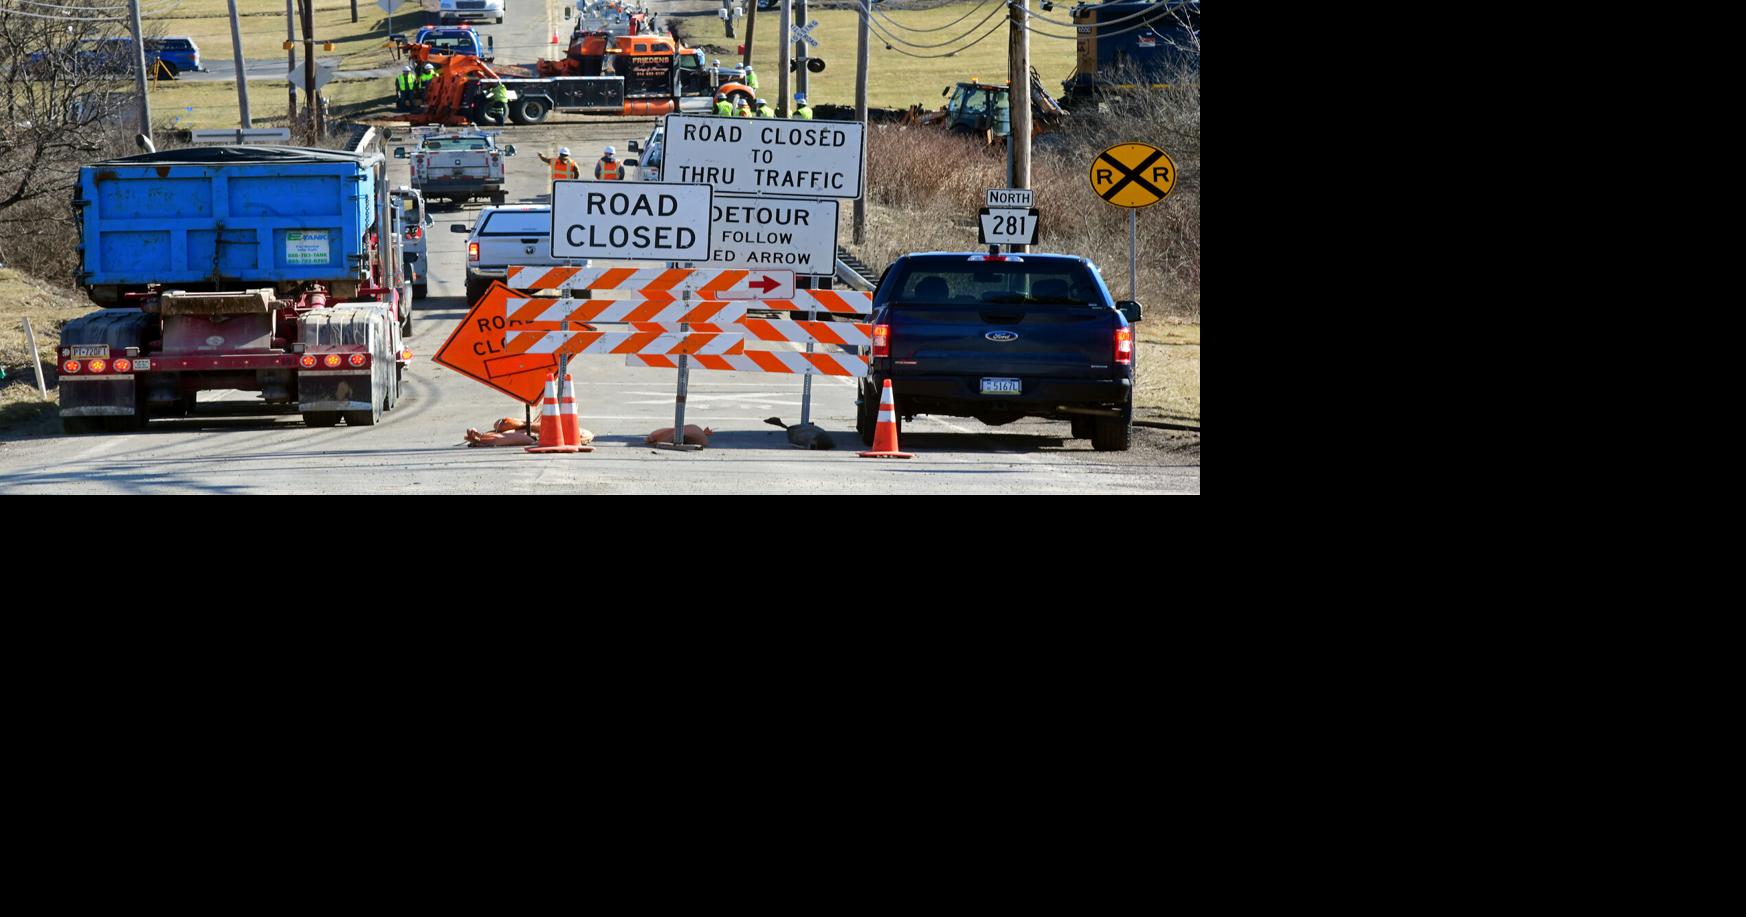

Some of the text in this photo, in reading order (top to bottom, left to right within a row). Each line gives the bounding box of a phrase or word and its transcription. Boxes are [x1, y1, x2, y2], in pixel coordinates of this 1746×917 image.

[683, 124, 846, 147] ROAD CLOSED
[751, 149, 774, 164] TO
[679, 165, 844, 189] THRU TRAFFIC
[1096, 166, 1169, 185] R R
[586, 192, 679, 217] ROAD
[990, 191, 1030, 203] NORTH
[712, 205, 810, 226] DETOUR
[992, 215, 1026, 236] 281
[566, 224, 696, 250] CLOSED
[722, 230, 793, 245] FOLLOW
[711, 250, 811, 265] ED ARROW
[992, 332, 1010, 340] Ford
